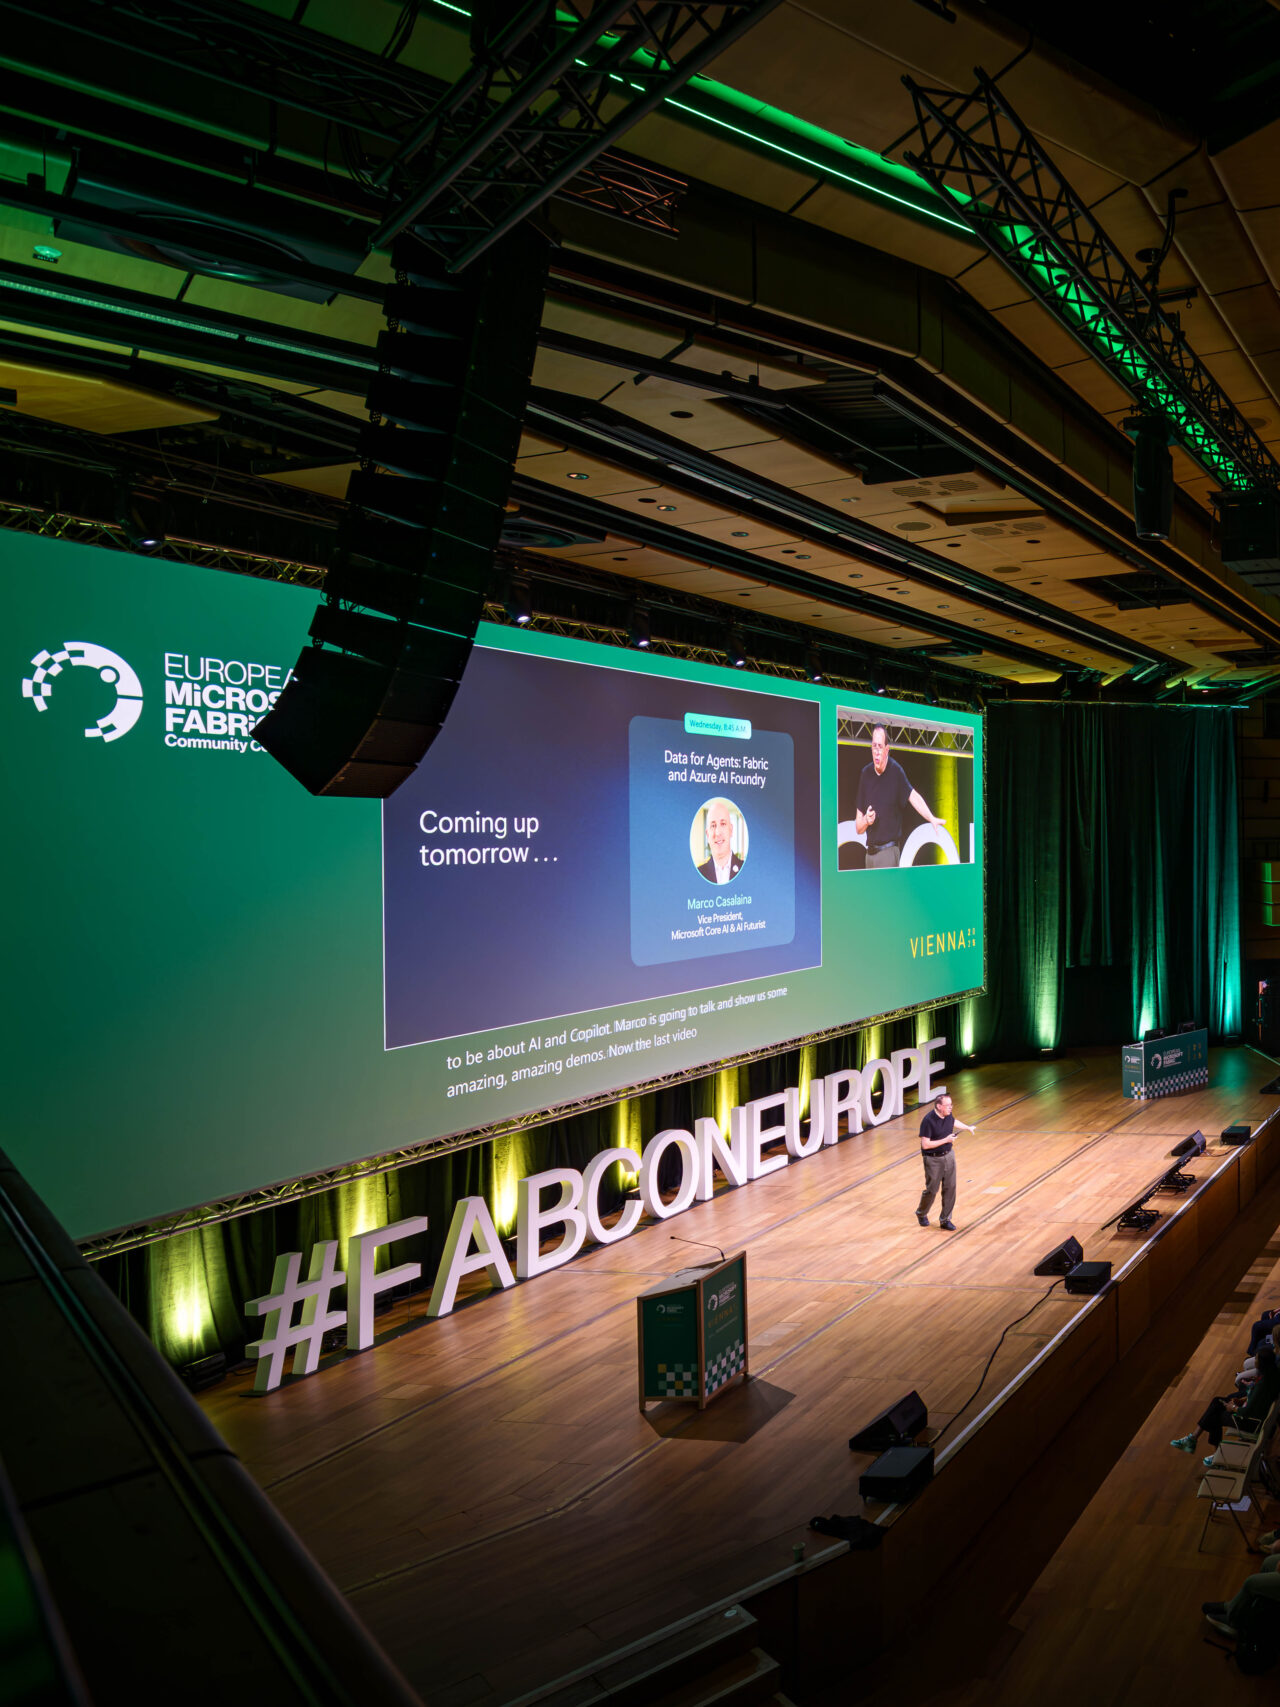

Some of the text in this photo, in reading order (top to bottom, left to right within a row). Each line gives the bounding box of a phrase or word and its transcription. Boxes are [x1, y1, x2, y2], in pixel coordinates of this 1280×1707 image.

[164, 652, 298, 689] EUROPEA
[689, 719, 723, 732] Wednesday,
[164, 733, 248, 753] Community
[664, 750, 769, 770] Data for Agents: Fabric
[668, 769, 766, 789] and Azure AI Foundry
[420, 810, 539, 839] Coming up
[687, 893, 752, 910] Marco Casalaina
[697, 911, 744, 924] Vice President,
[671, 919, 767, 940] Microsoft Core AI & AI Futurist
[910, 929, 966, 959] VIENNA
[446, 986, 788, 1070] to be about AI and Copilot. Marco is going to talk and show us some
[446, 1027, 698, 1098] amazing, amazing demos. Now the last video
[245, 1036, 948, 1393] #FABCONEUROPE
